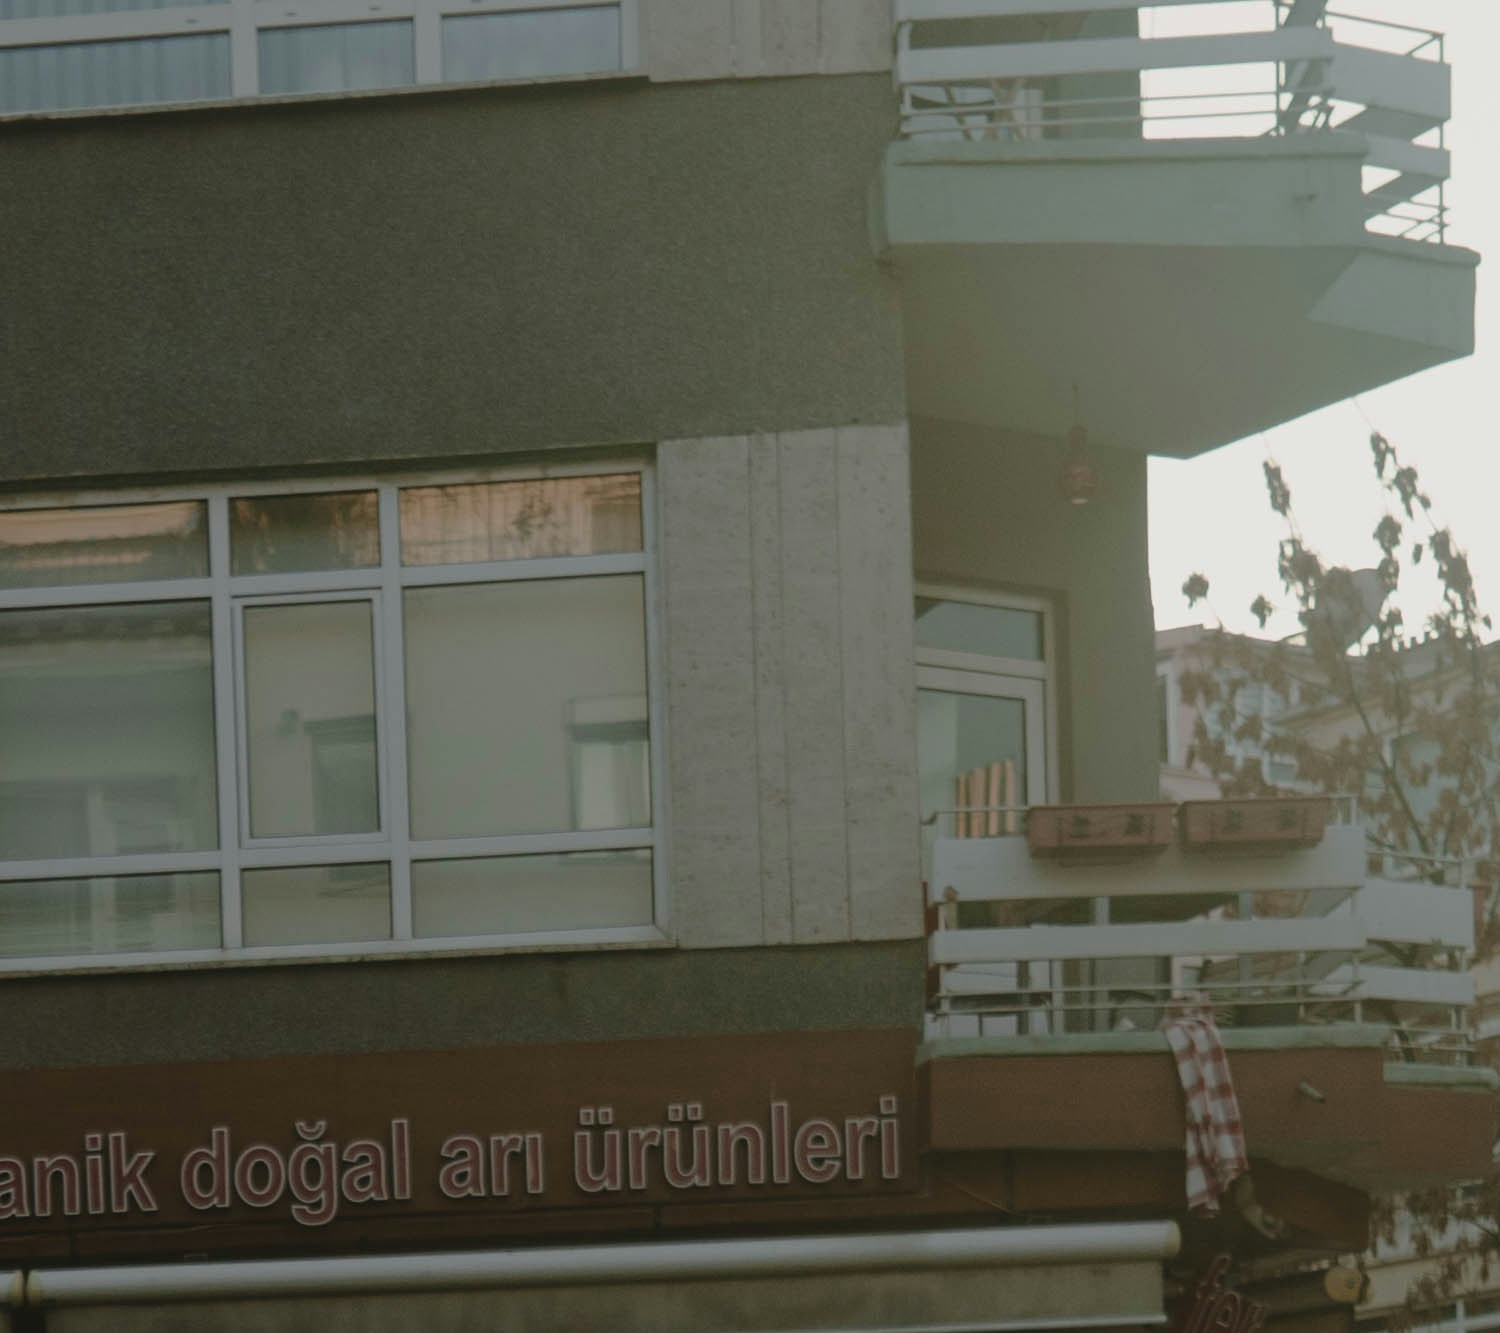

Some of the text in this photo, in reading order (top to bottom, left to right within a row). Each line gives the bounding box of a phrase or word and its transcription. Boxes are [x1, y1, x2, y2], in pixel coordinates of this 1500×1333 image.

[181, 1117, 412, 1227] doğal
[438, 1132, 544, 1199] arı
[573, 1094, 901, 1193] ürünleri
